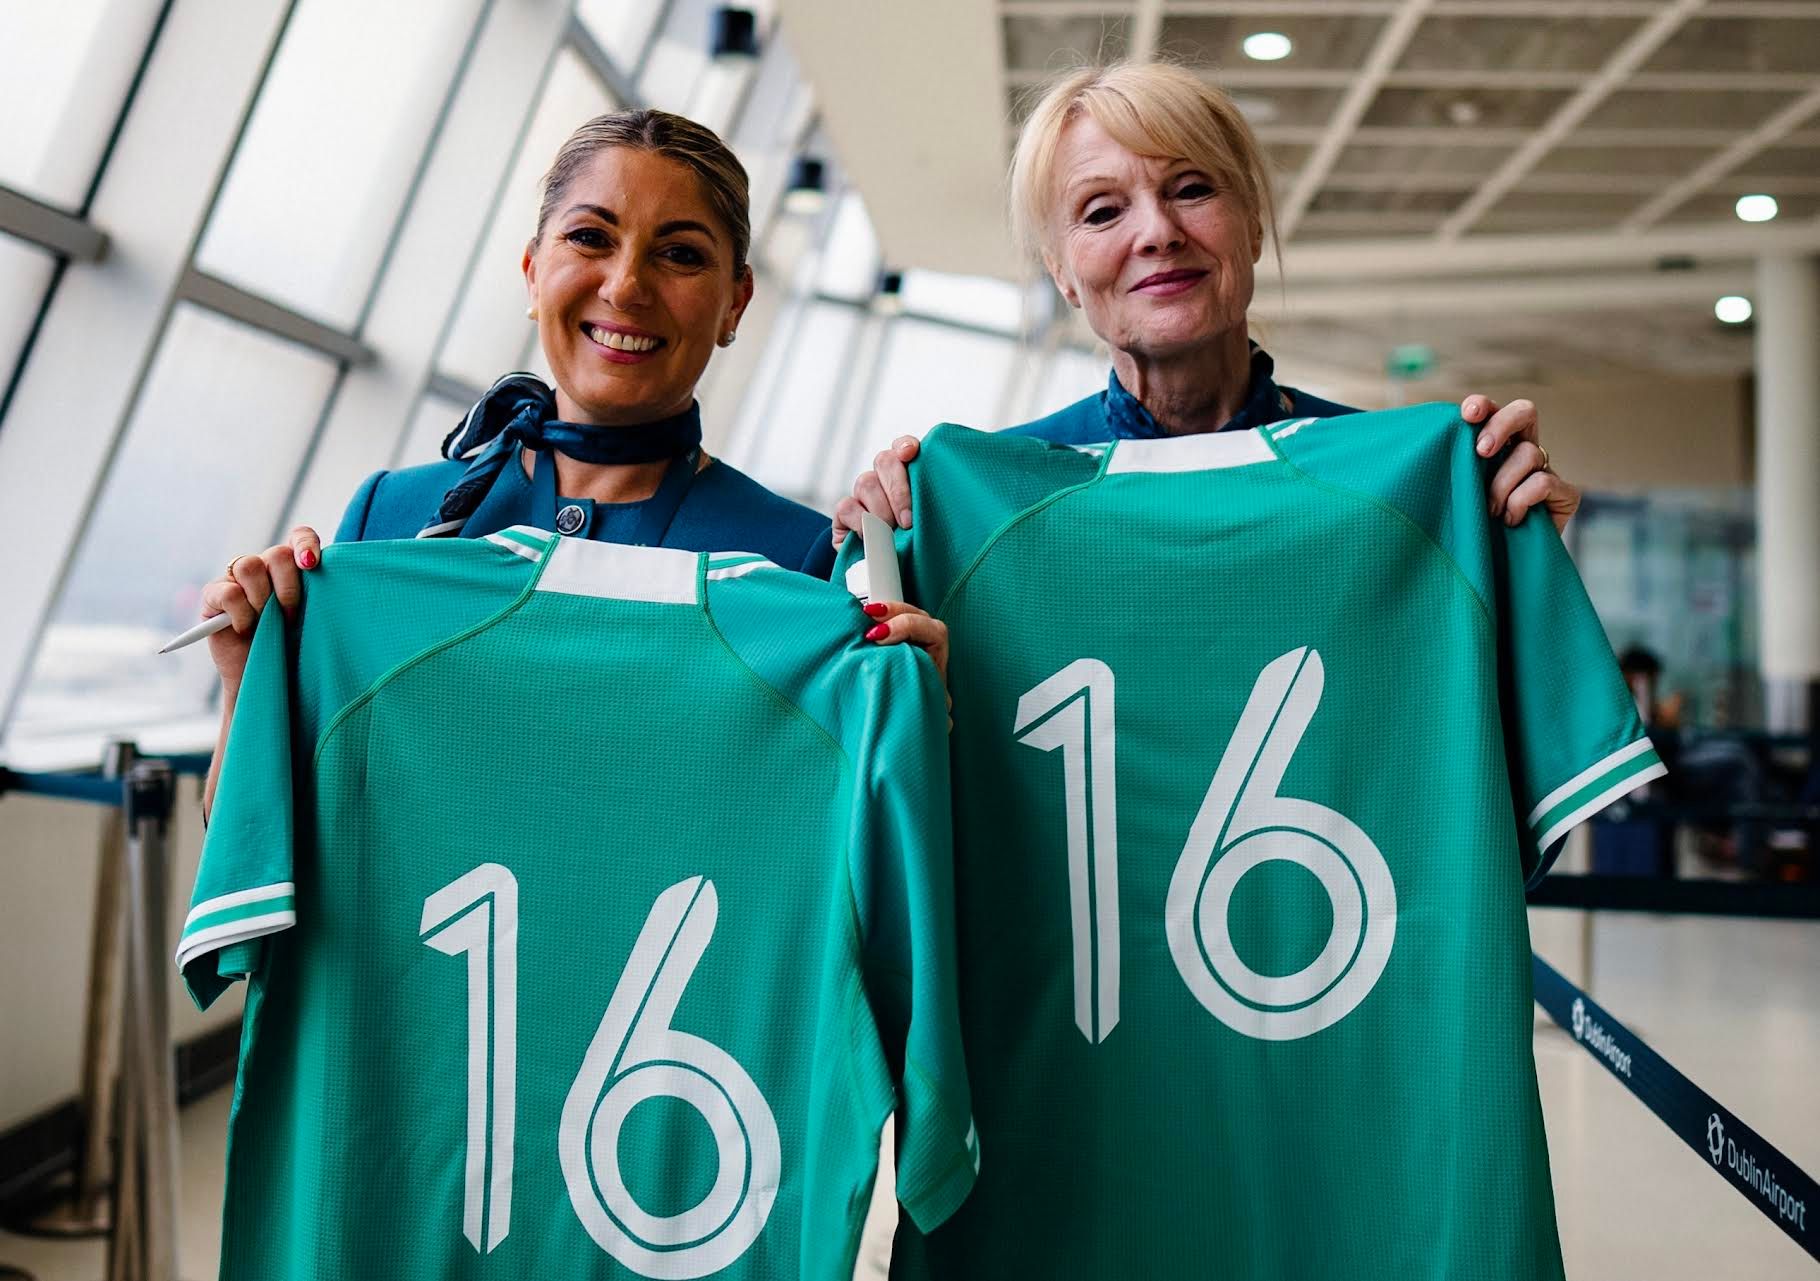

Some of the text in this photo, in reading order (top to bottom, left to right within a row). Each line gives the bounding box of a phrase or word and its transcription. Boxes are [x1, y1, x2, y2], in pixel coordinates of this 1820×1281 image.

[1014, 646, 1397, 1042] 16
[420, 863, 781, 1281] 16
[1727, 1138, 1806, 1231] DublinAirport
